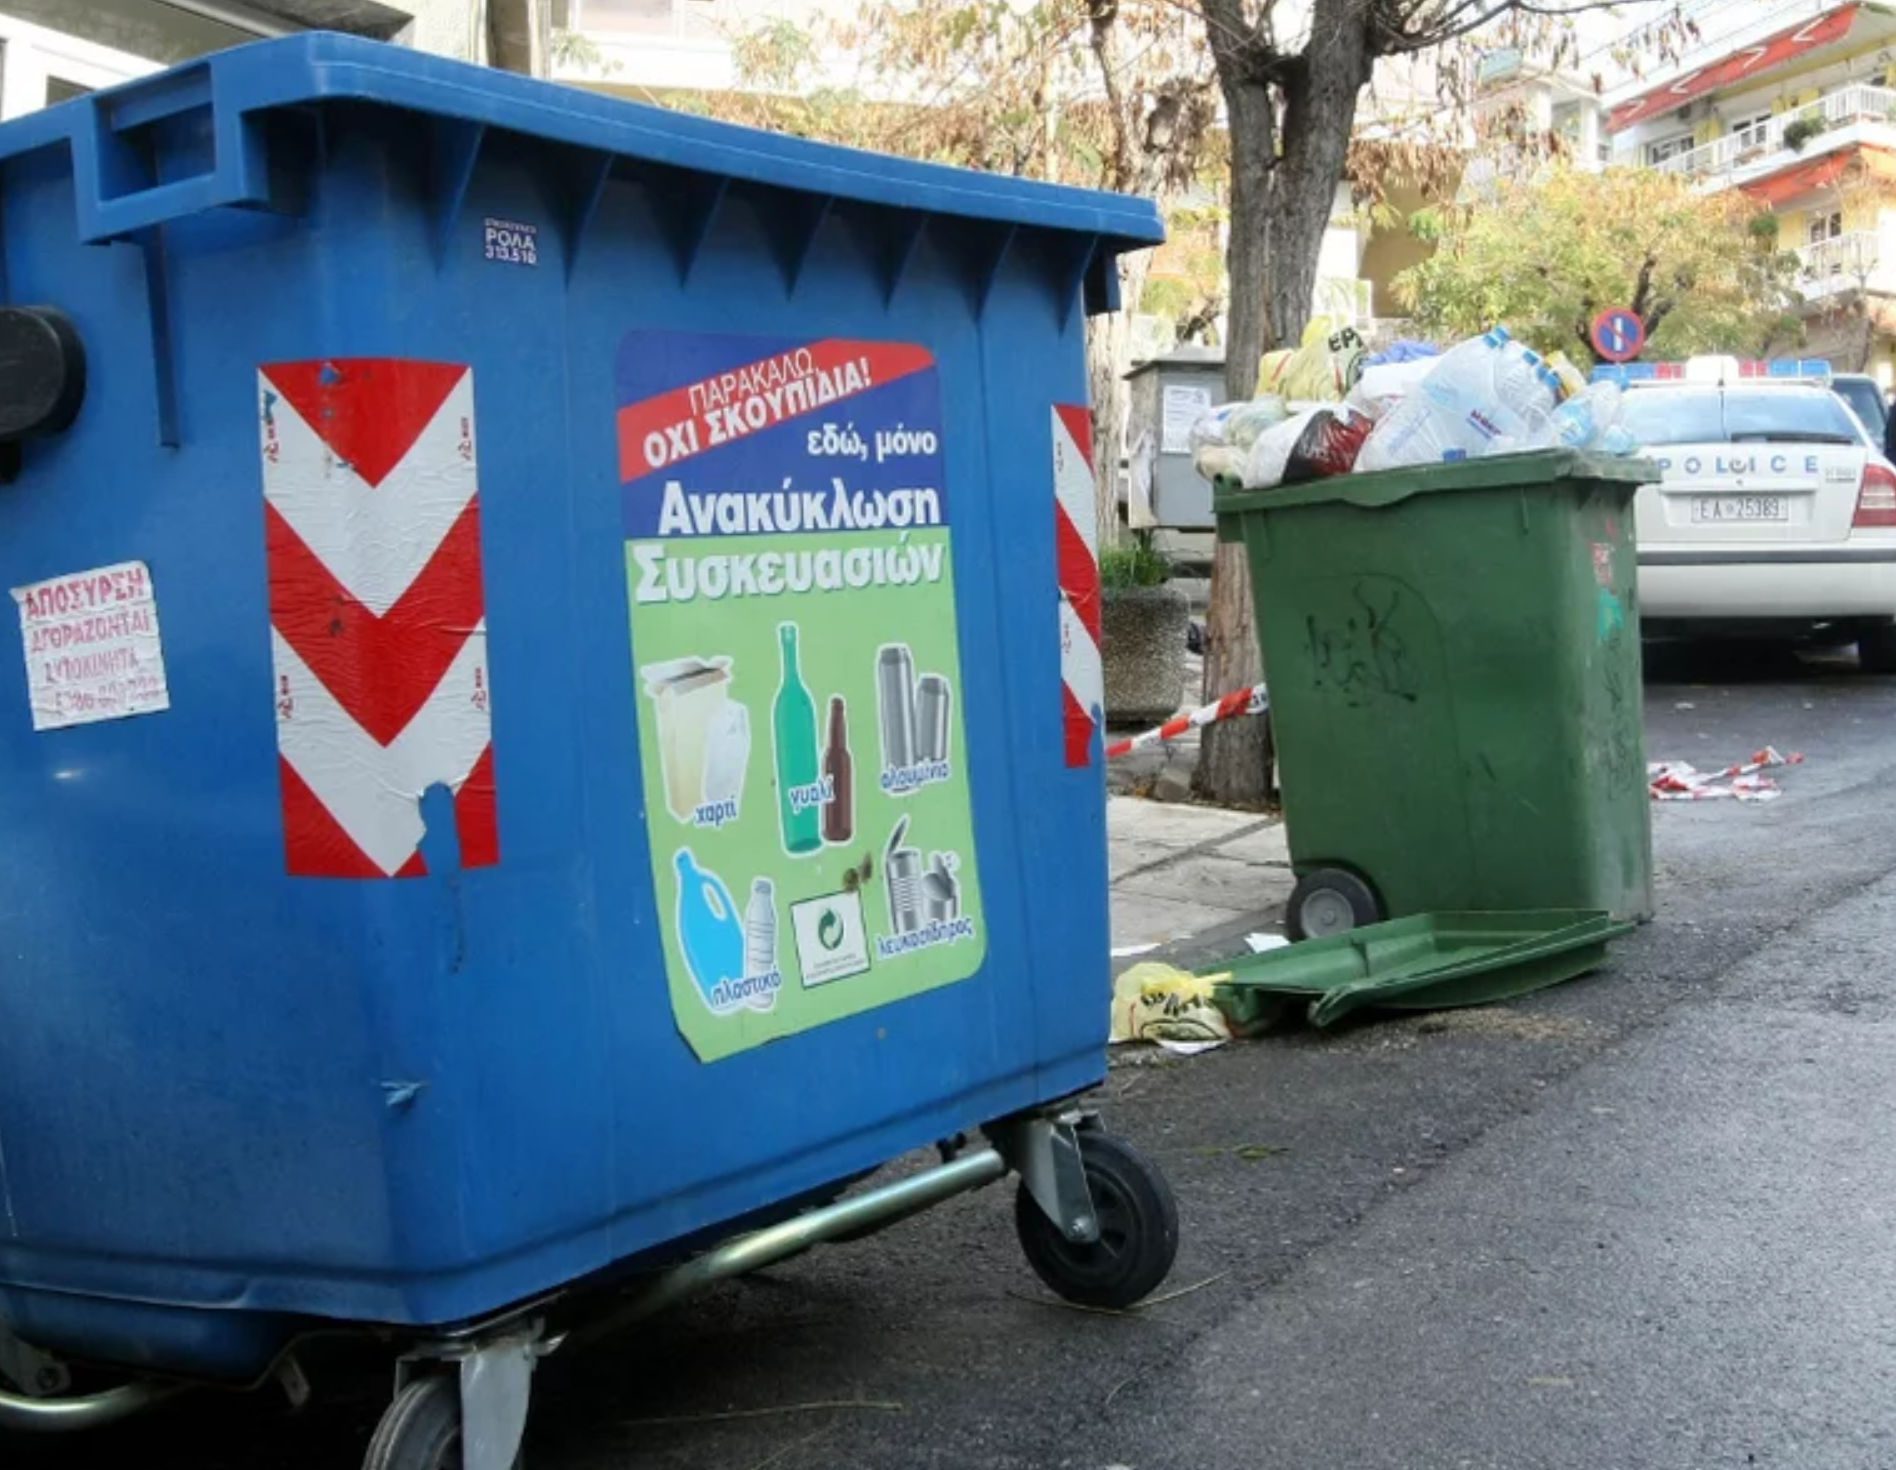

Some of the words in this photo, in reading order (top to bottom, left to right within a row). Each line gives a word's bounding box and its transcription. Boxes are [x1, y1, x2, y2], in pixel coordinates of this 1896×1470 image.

[643, 418, 700, 469] ΟΧΙ
[703, 357, 873, 446] ΣΚΟΥΠΙΔΙΑ!
[807, 422, 868, 461] εδώ,
[875, 424, 937, 463] μόνο
[1656, 455, 1818, 474] POLICE
[658, 477, 940, 535] Ανακύκλωση
[632, 531, 945, 603] Συσκευασιών
[694, 794, 737, 827] χαρτί
[790, 779, 833, 812] γυαλί
